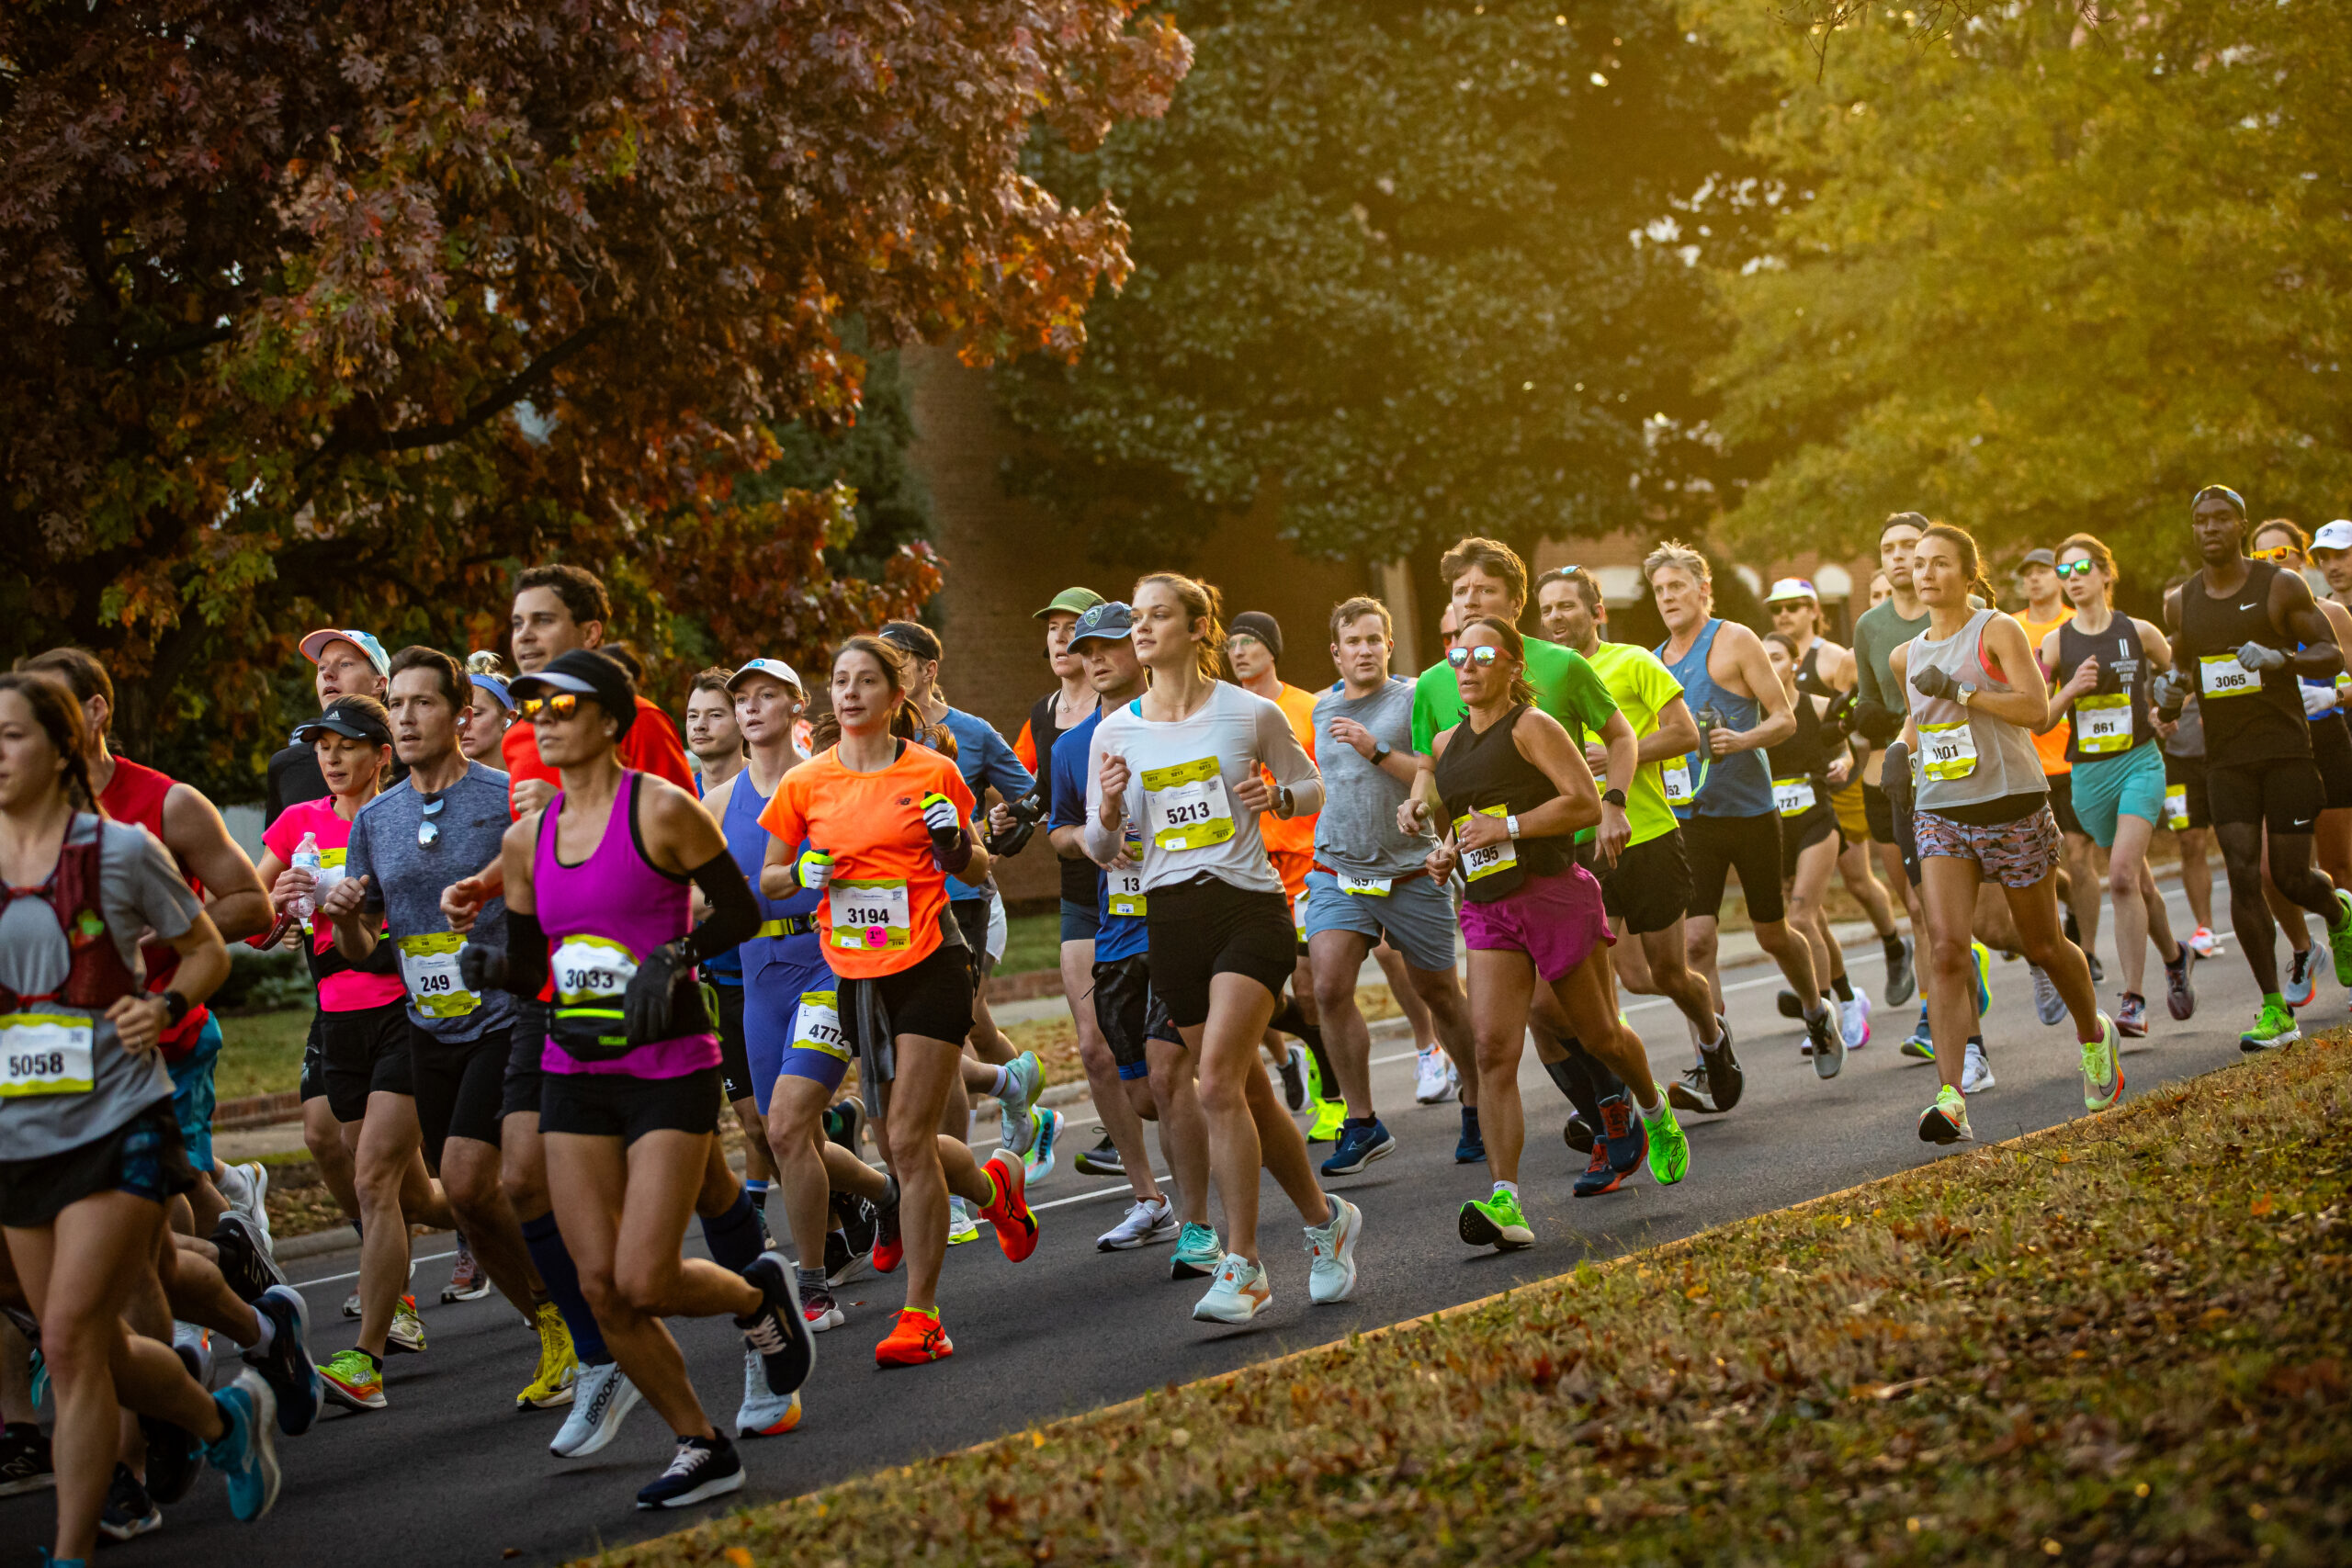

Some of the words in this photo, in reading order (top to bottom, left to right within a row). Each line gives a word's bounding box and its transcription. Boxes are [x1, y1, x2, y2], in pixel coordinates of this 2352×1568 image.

[2215, 673, 2246, 688] 3065
[2093, 721, 2115, 735] 861
[1166, 801, 1211, 825] 5213
[1470, 845, 1499, 868] 3295
[847, 907, 890, 924] 3194
[420, 974, 451, 992] 249
[565, 968, 615, 989] 3033
[9, 1052, 64, 1077] 5058
